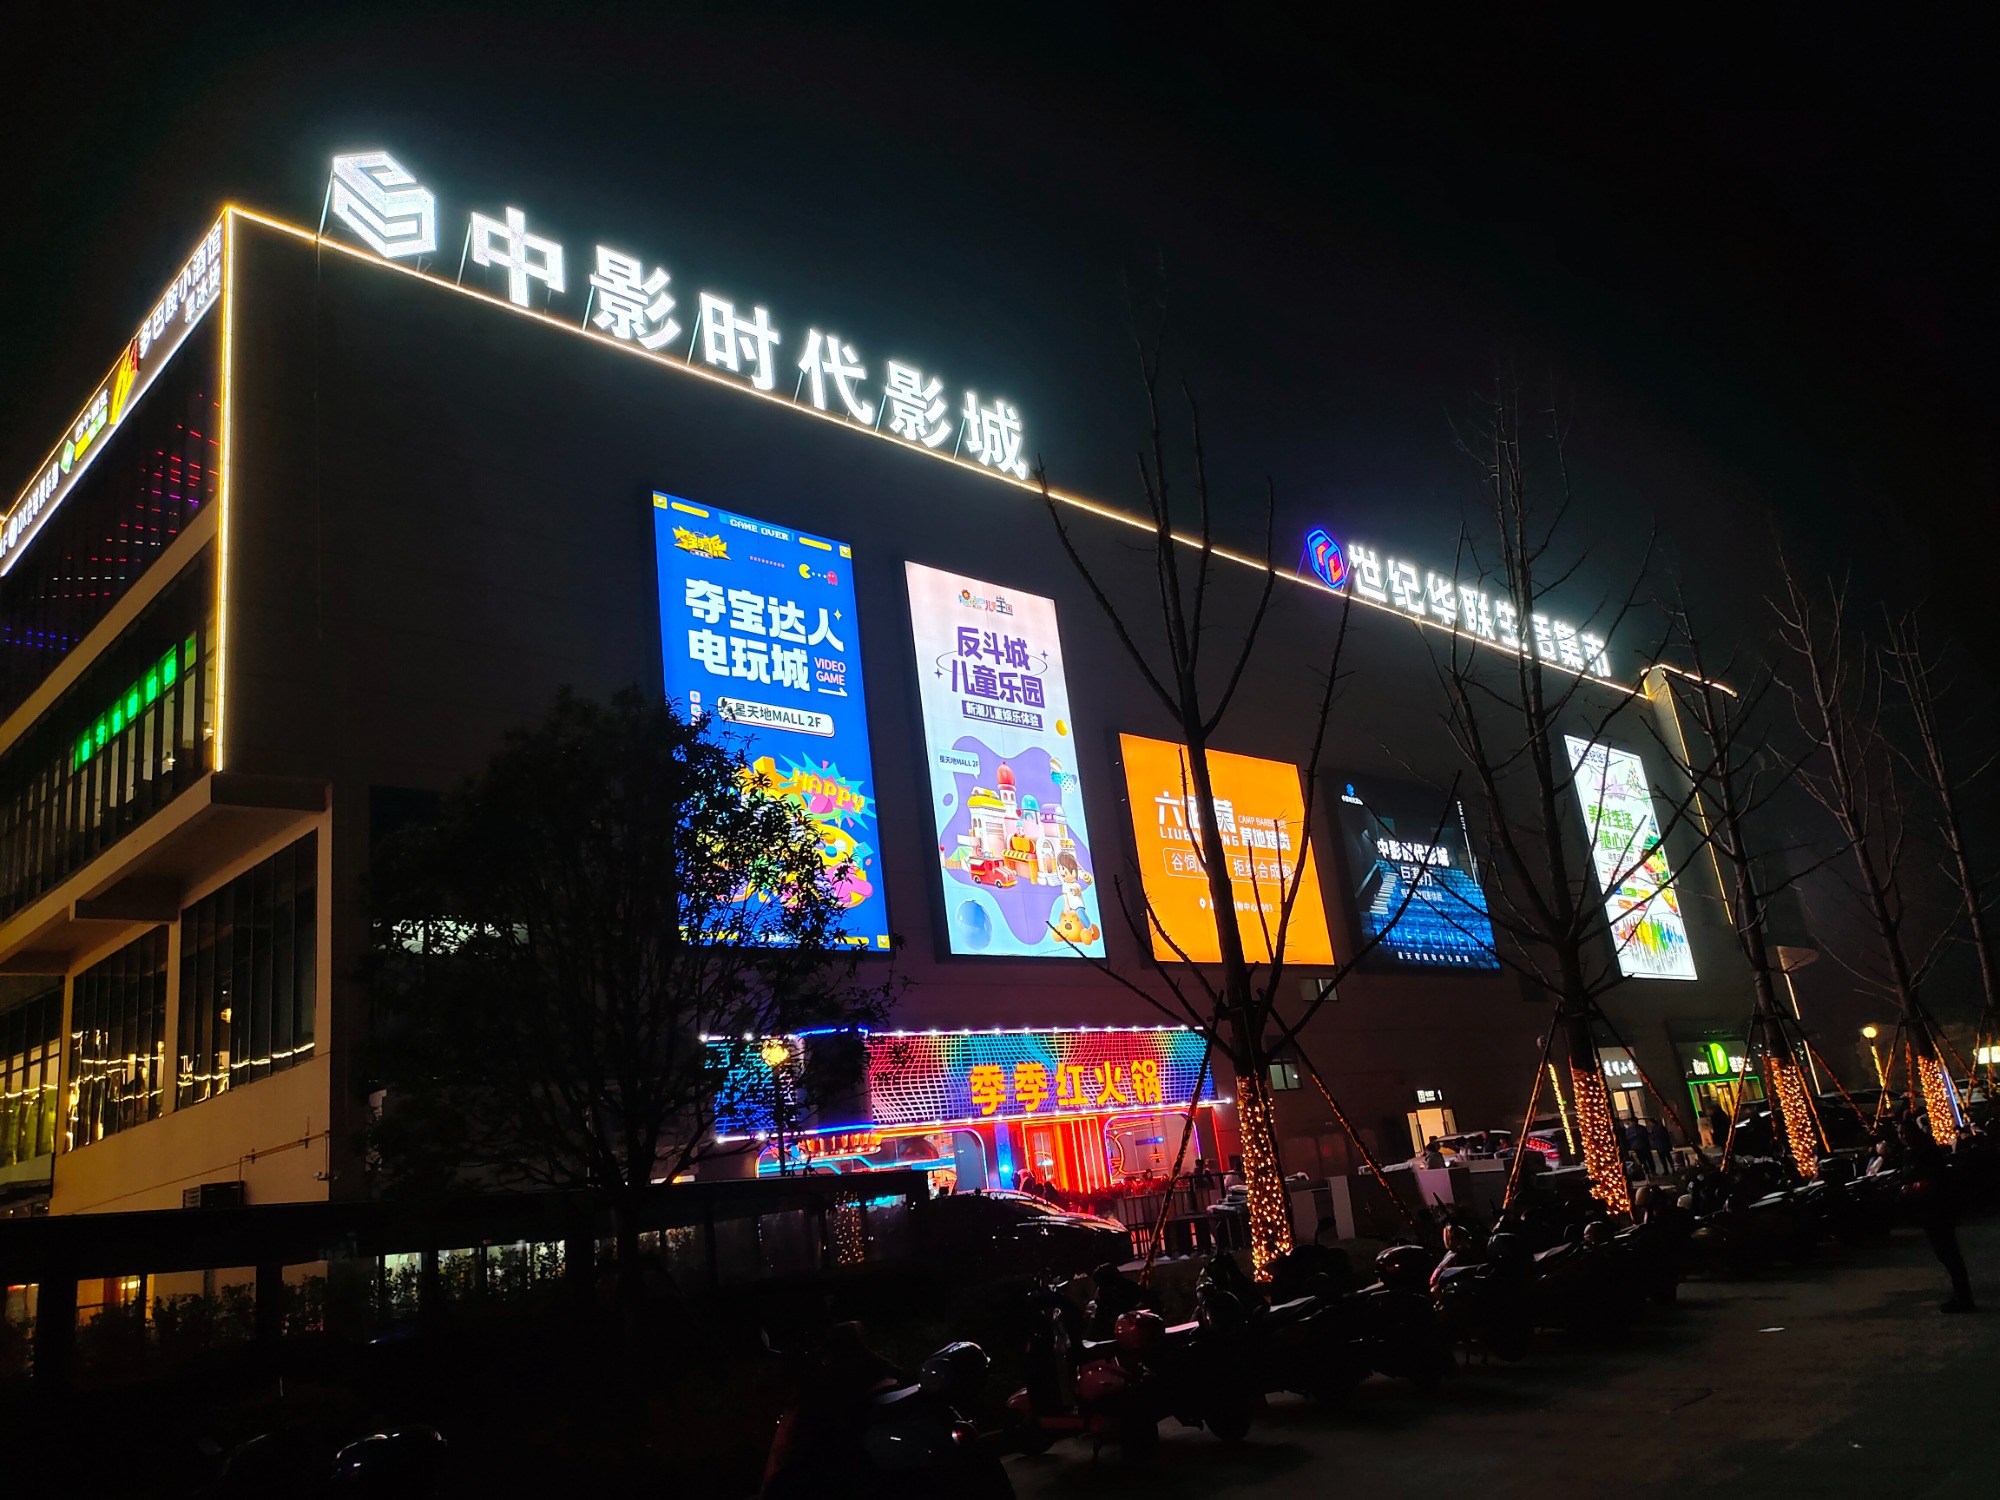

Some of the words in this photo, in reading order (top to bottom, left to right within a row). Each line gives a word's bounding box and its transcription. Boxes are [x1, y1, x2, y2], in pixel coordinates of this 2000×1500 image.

[471, 207, 1027, 480] 中影时代影城
[729, 517, 758, 533] GAME
[761, 527, 789, 542] OVER
[685, 578, 844, 652] 夺宝达人
[688, 629, 811, 691] 电玩城
[814, 656, 846, 674] VIDEO
[957, 626, 1030, 670] 反斗城
[816, 671, 845, 686] GAME
[952, 659, 1045, 708] 儿童乐园
[807, 715, 821, 728] 2F
[789, 768, 865, 814] HAPPY
[1238, 815, 1255, 825] CAMP
[1377, 838, 1450, 867] 中影时代影城
[970, 1059, 1161, 1114] 季季红火锅
